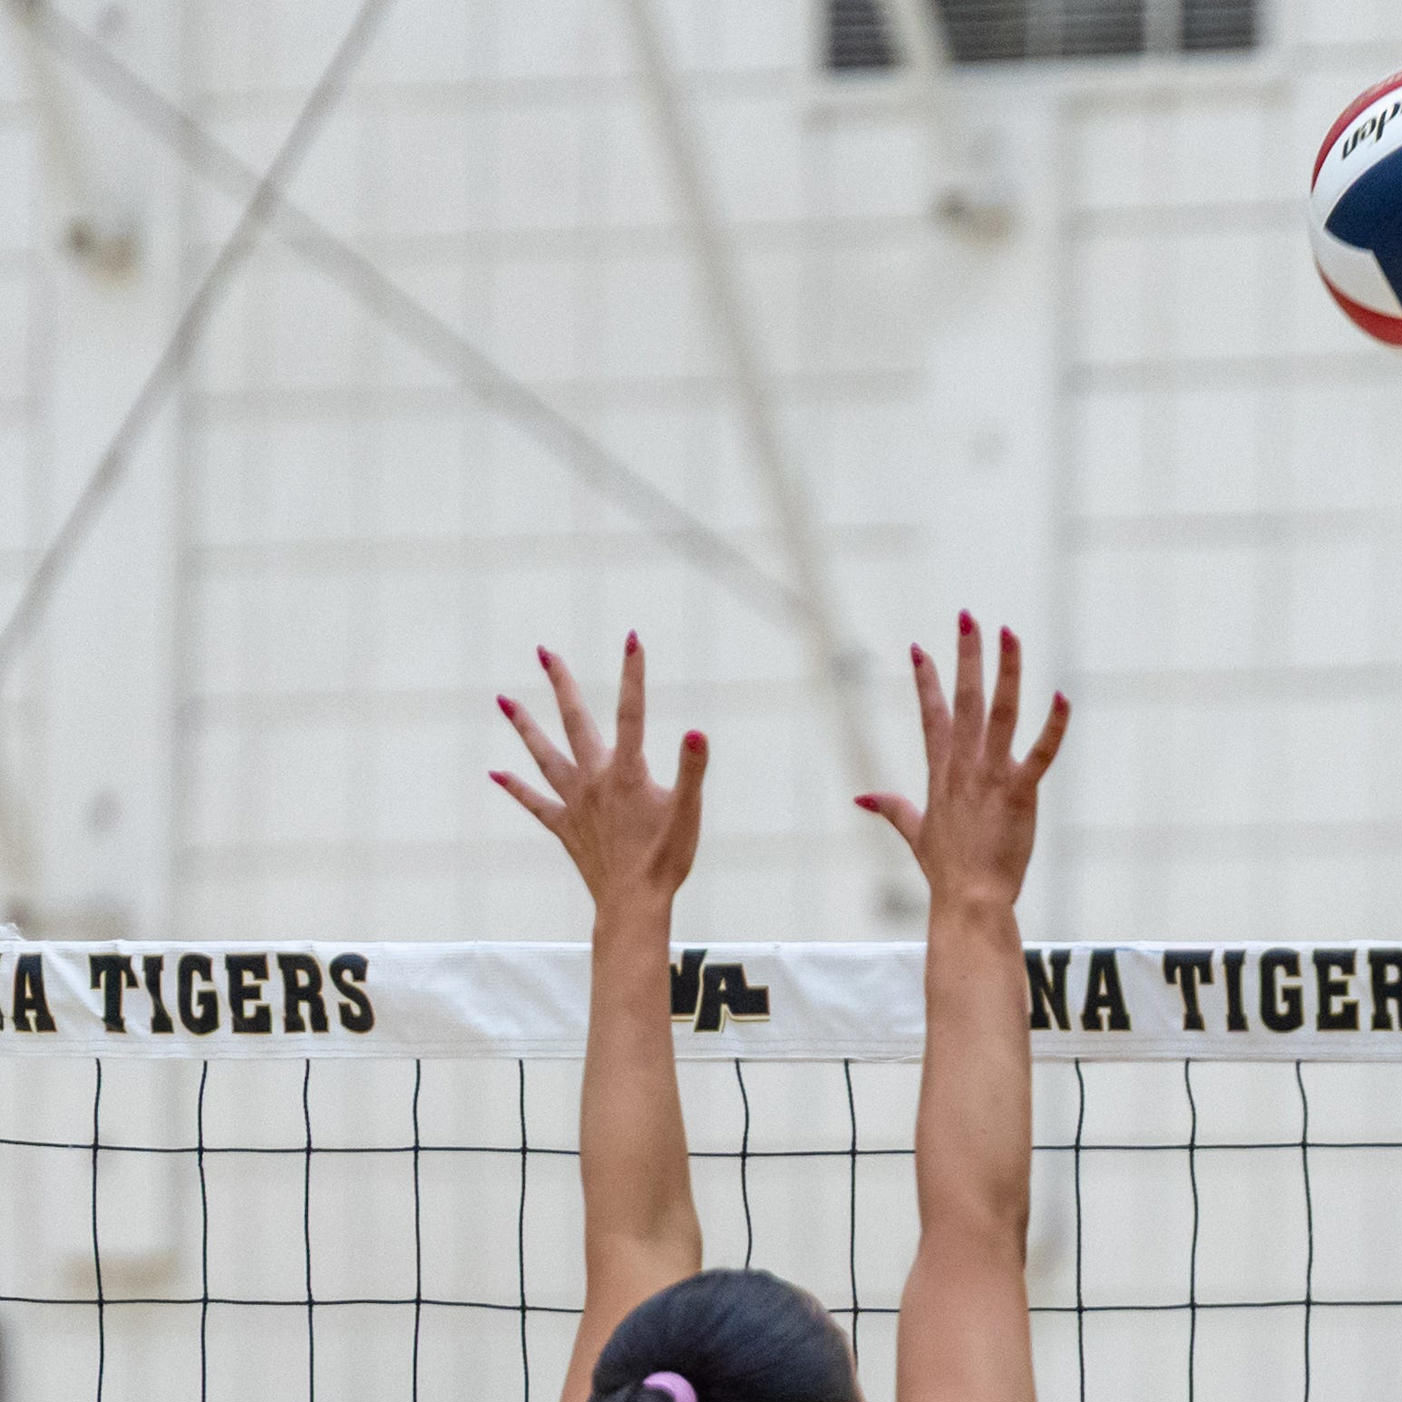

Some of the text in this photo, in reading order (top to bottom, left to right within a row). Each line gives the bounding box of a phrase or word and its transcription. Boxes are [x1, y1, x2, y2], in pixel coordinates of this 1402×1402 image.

[0, 953, 375, 1037] A TIGERS
[1023, 950, 1132, 1033] NA
